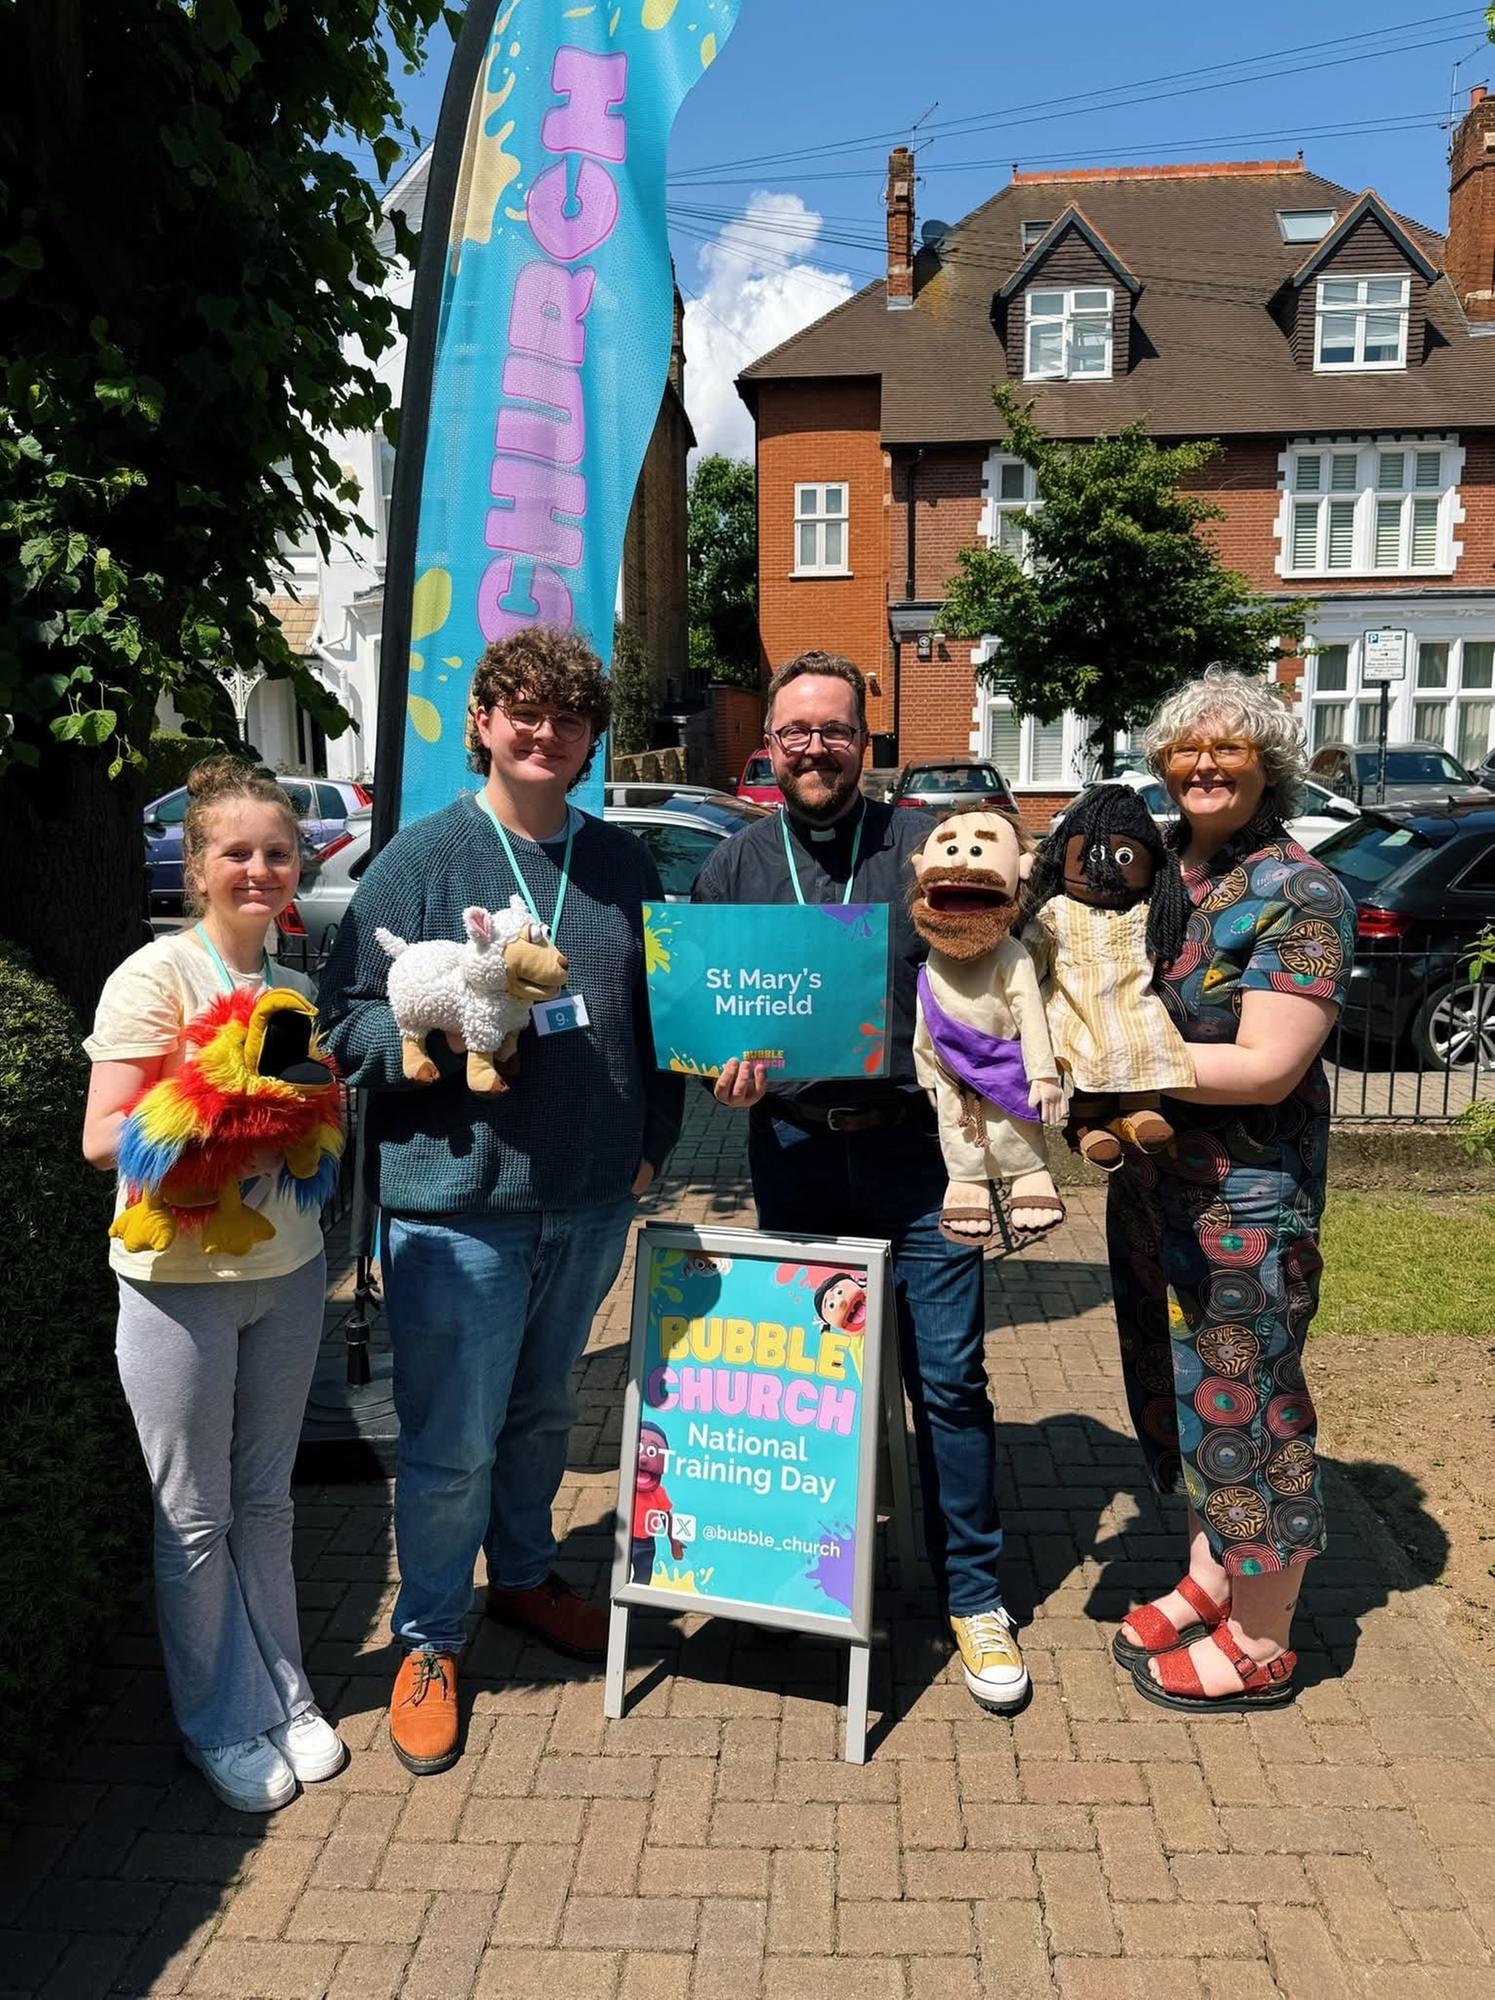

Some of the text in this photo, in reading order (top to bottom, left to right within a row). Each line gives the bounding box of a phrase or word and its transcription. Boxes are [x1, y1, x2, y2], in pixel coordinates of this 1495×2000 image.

[477, 45, 628, 645] CHURCH
[705, 967, 823, 995] St Mary's
[715, 993, 813, 1017] Mirfield
[743, 1049, 785, 1060] BUBBLE
[659, 1316, 850, 1380] BUBBLE
[647, 1364, 857, 1436] CHURCH
[687, 1421, 808, 1463] National
[658, 1447, 837, 1504] Training Day
[702, 1525, 841, 1560] @bubble_church
